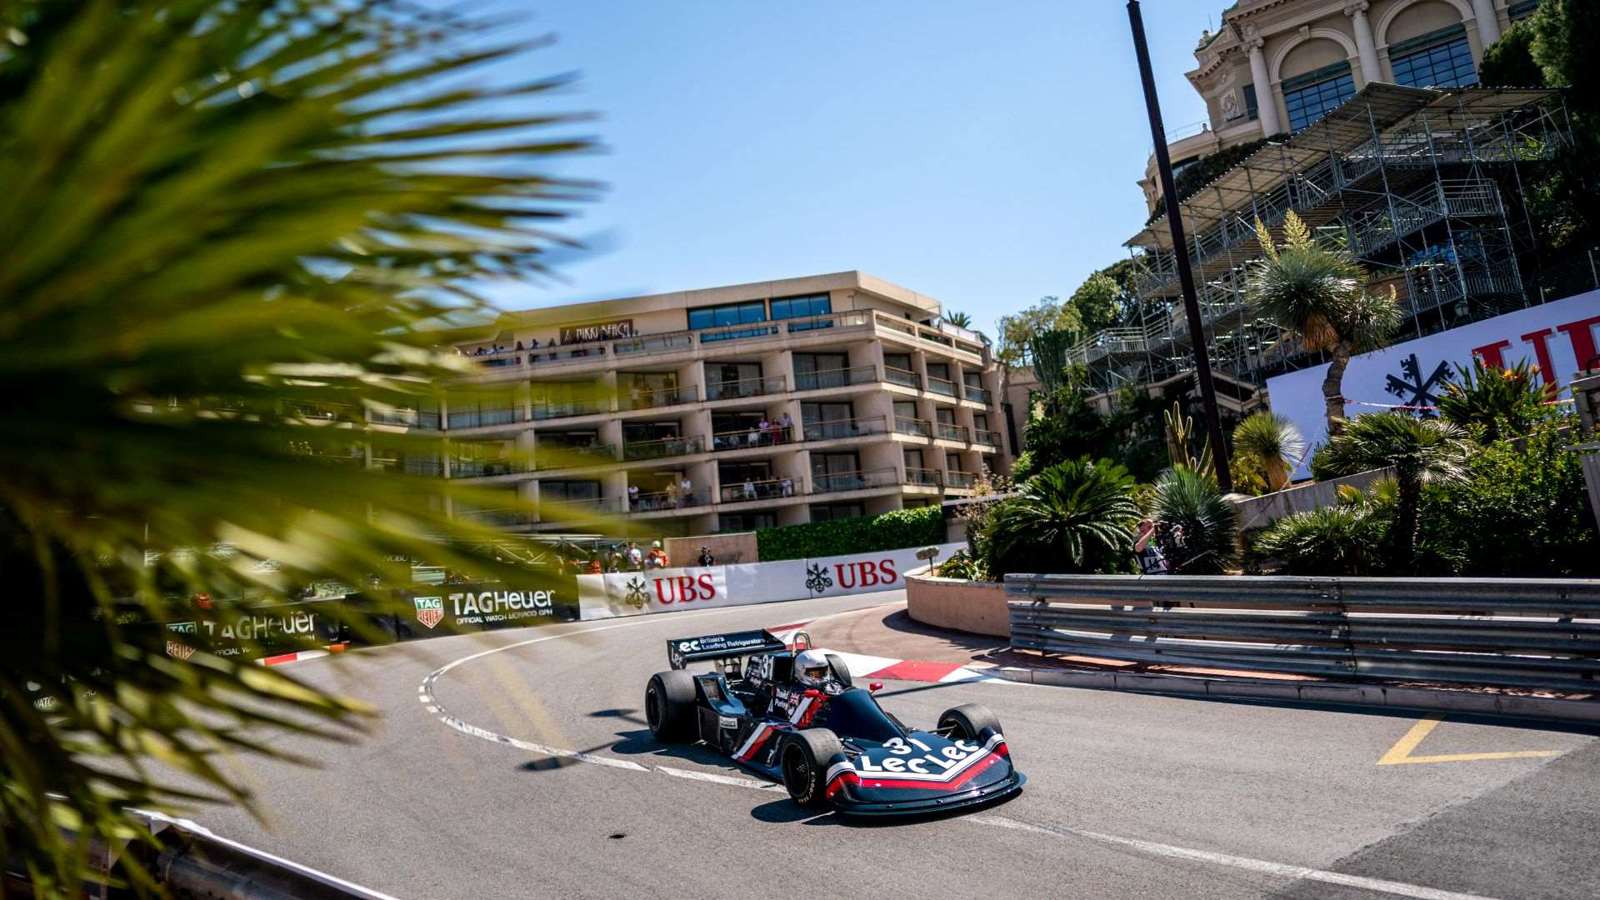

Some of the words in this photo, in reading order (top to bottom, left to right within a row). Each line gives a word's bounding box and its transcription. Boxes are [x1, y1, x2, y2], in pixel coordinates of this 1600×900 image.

[834, 559, 898, 589] UBS
[653, 573, 716, 605] UBS
[416, 598, 441, 610] TAG
[456, 616, 483, 625] OFFICIAL
[485, 614, 508, 623] WATCH
[761, 655, 775, 680] 31
[882, 736, 933, 755] 31
